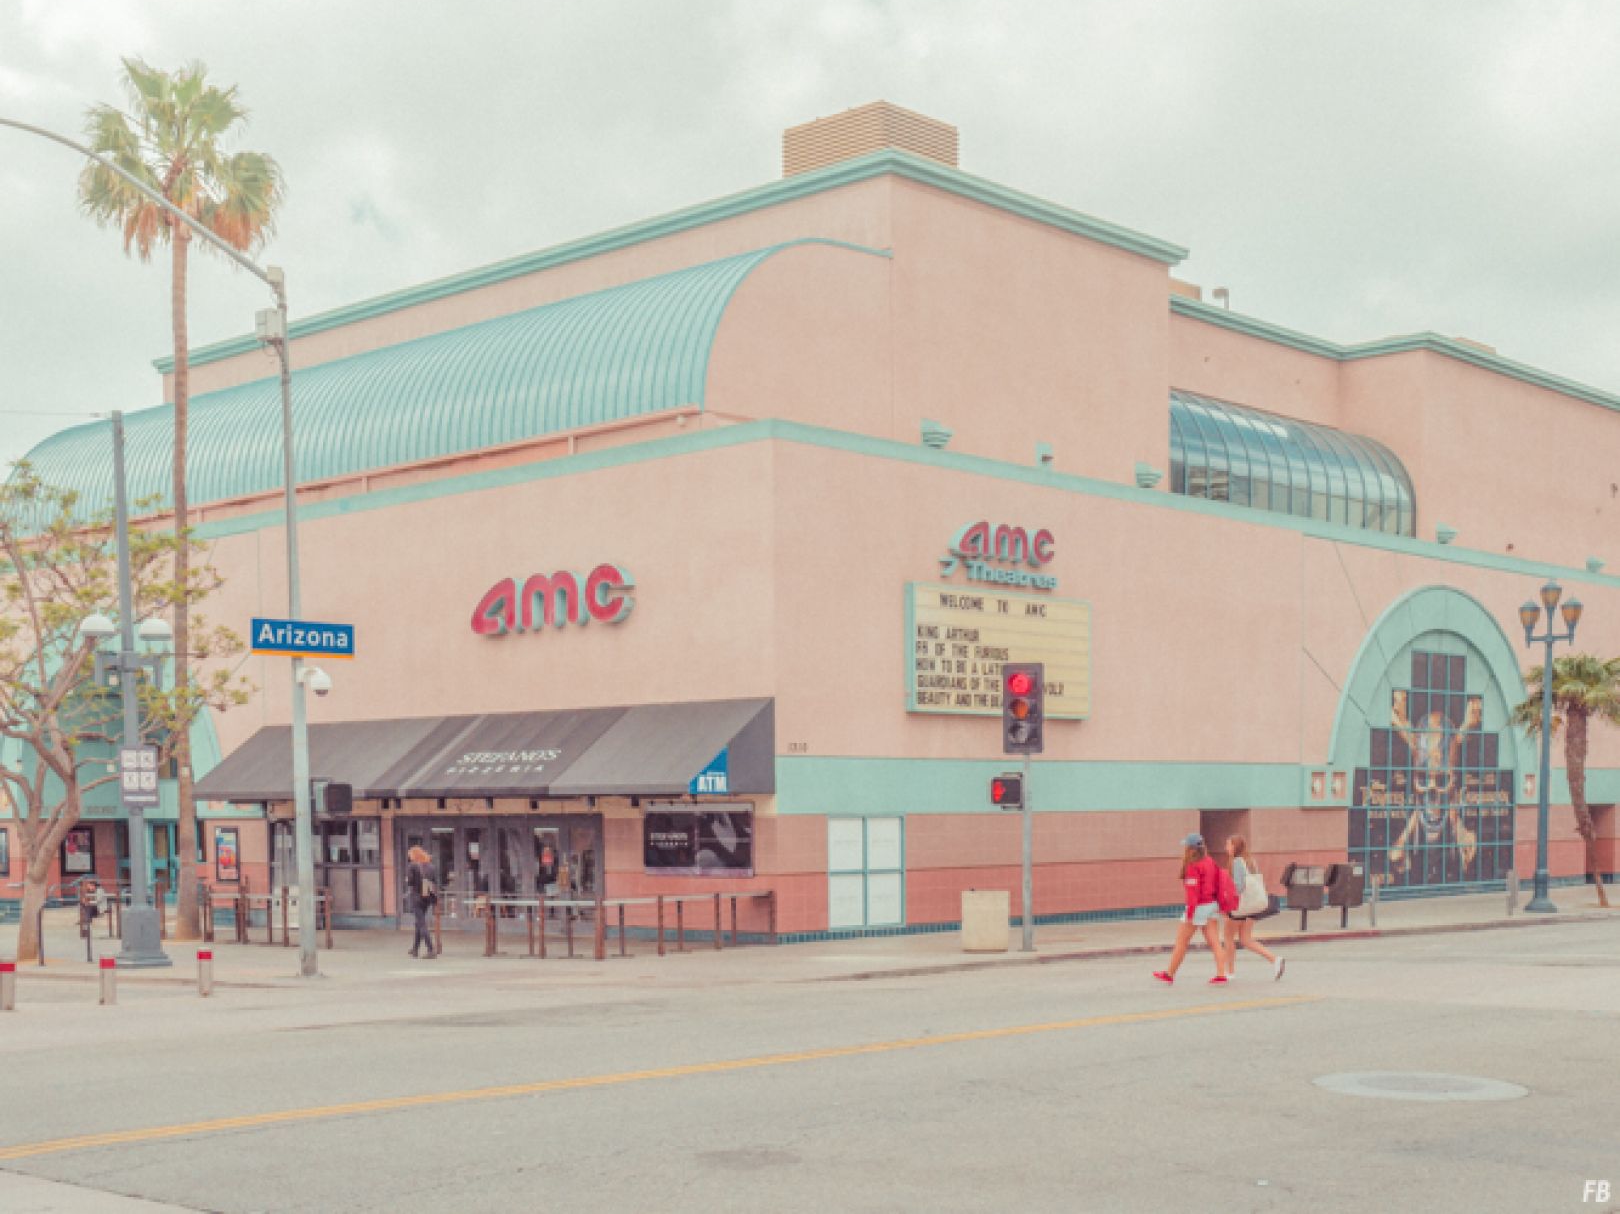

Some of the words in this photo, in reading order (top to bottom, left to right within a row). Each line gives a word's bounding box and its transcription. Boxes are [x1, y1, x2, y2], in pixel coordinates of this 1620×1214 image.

[940, 594, 984, 611] WELCOME
[1025, 604, 1047, 617] AMC
[258, 623, 348, 648] Arizona
[917, 626, 938, 639] KING
[947, 628, 979, 641] ARTHUR
[952, 644, 968, 658] THE
[974, 646, 1008, 661] FURIOUS
[917, 675, 967, 690] GUARDIANS
[984, 677, 1000, 692] THE
[917, 691, 951, 705] BEAUTY
[697, 775, 727, 792] ATM
